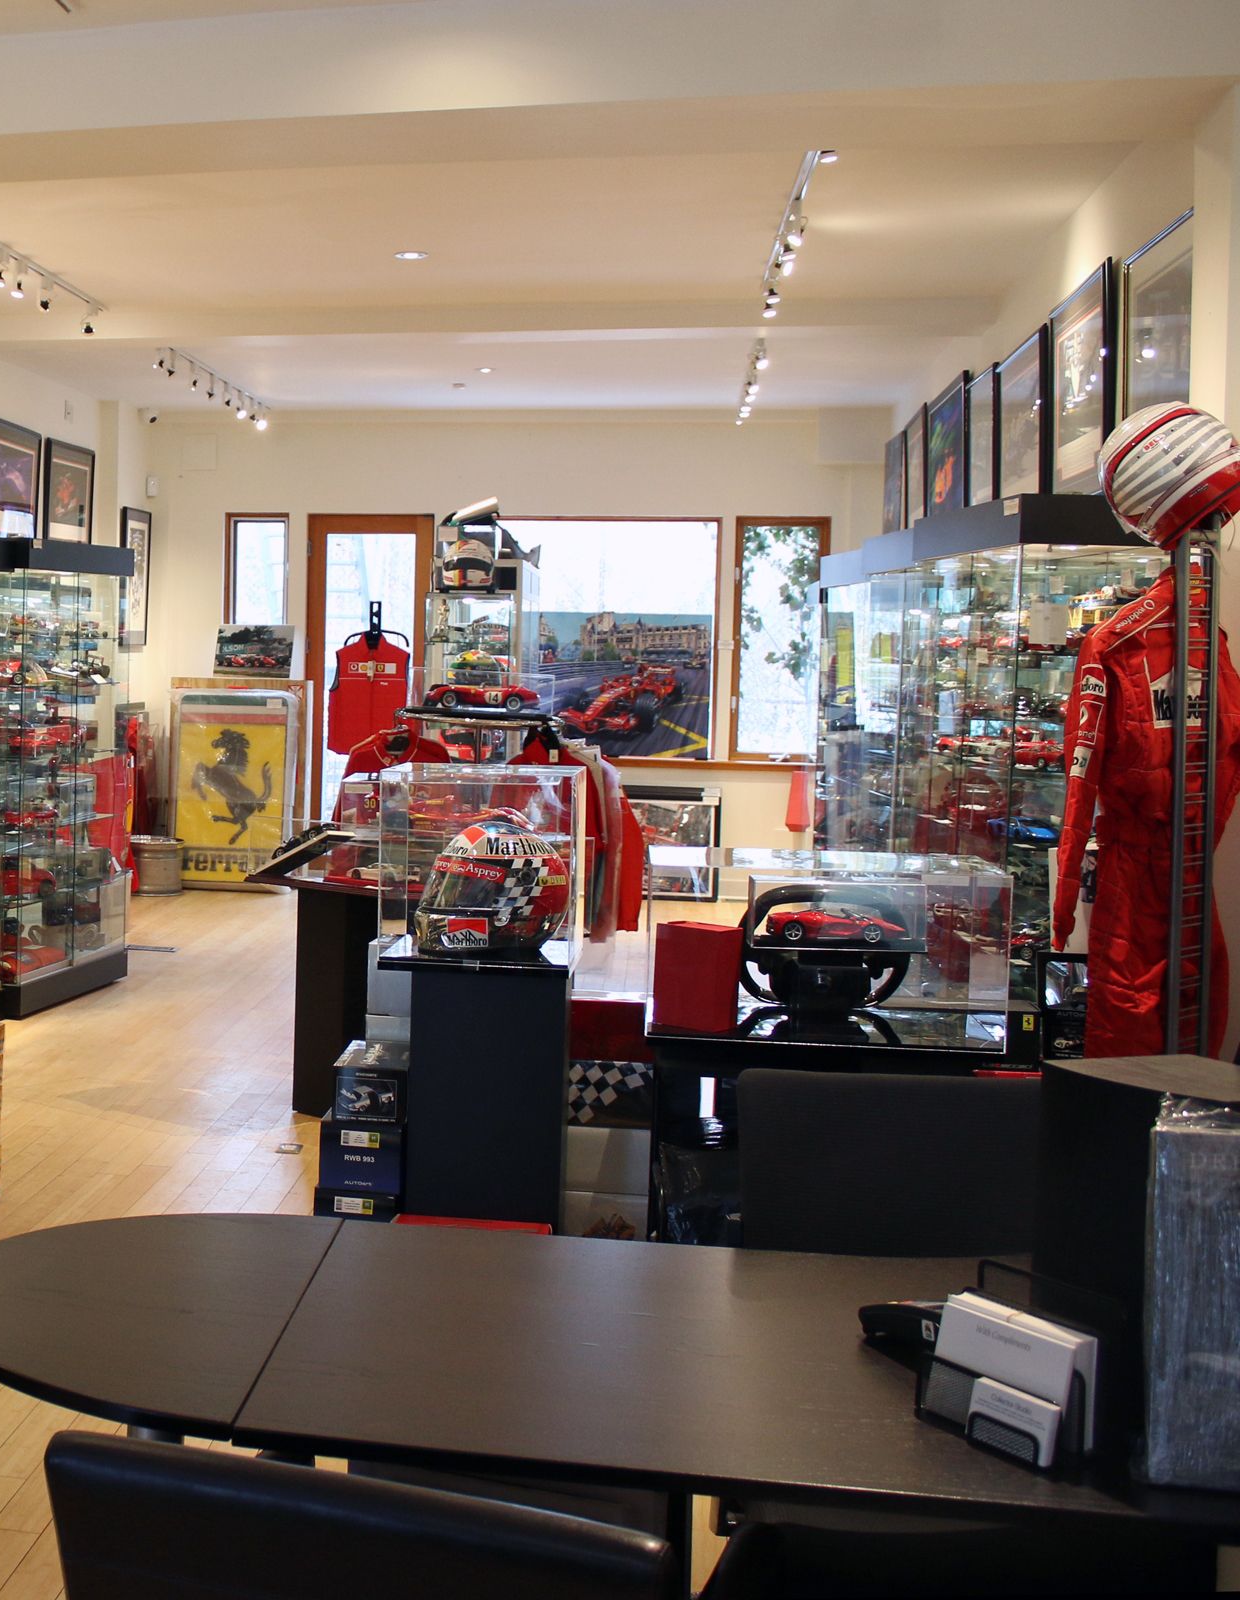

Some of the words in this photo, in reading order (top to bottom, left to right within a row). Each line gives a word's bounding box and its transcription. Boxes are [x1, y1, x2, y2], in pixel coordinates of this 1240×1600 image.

[486, 836, 551, 857] Marlbor
[181, 847, 268, 873] Ferrar
[465, 863, 503, 880] Asprey
[344, 1153, 361, 1162] RWB
[362, 1155, 375, 1163] 993
